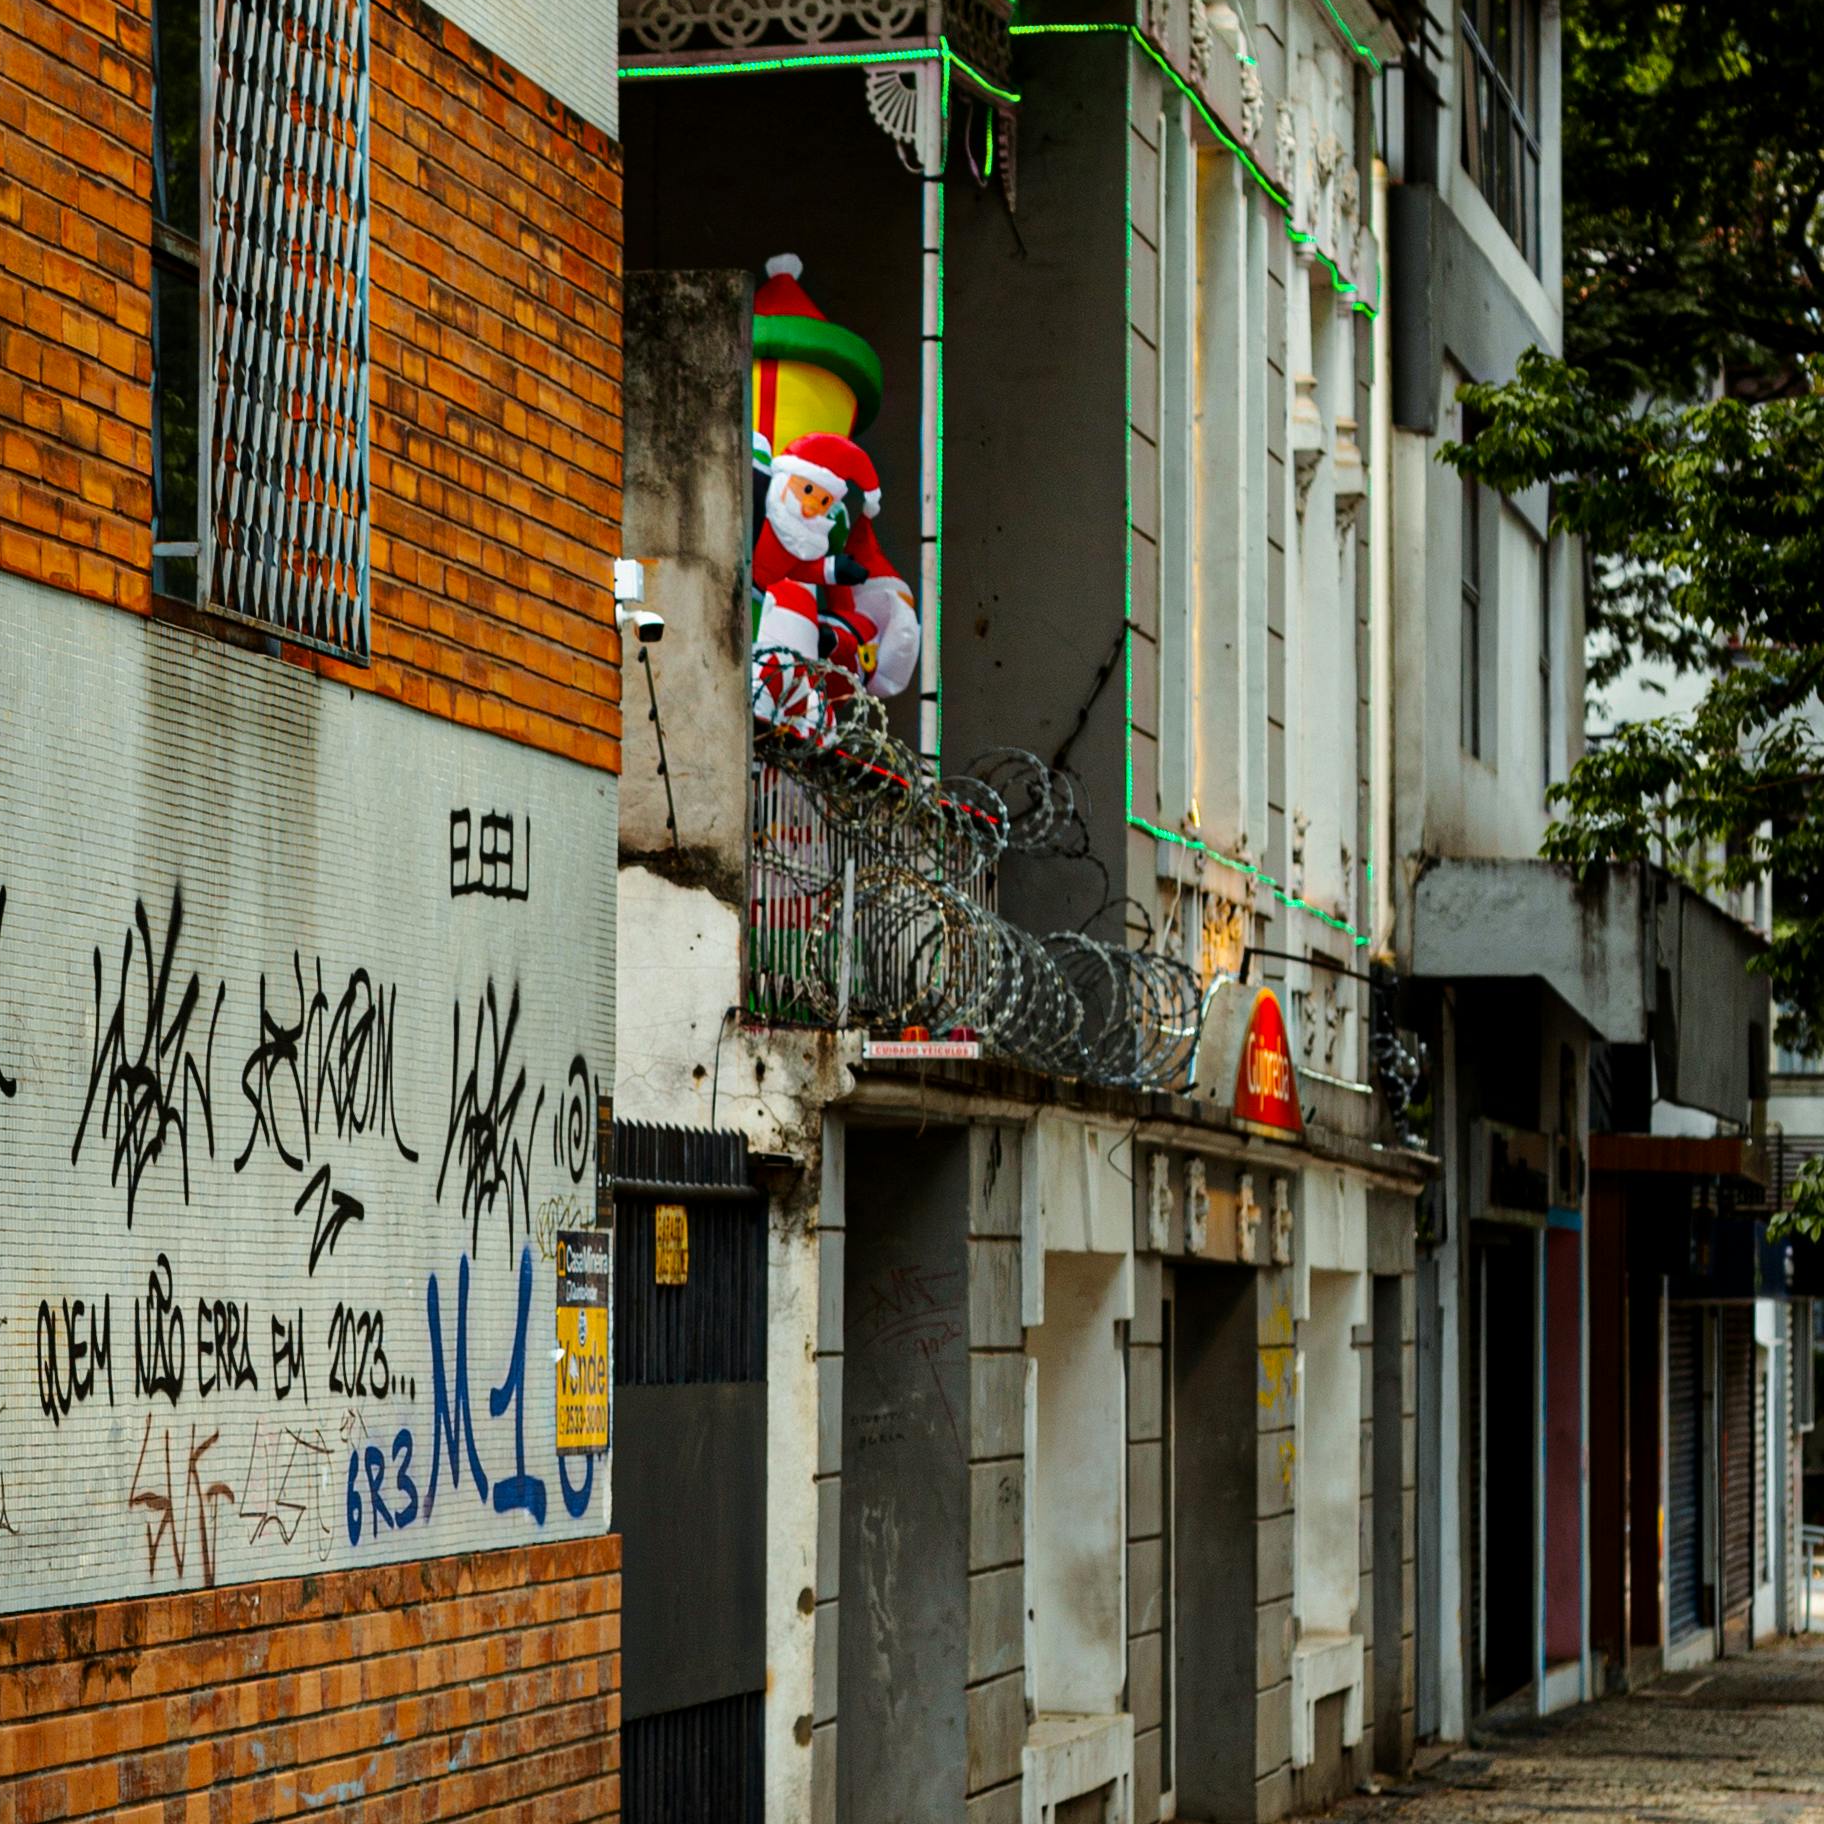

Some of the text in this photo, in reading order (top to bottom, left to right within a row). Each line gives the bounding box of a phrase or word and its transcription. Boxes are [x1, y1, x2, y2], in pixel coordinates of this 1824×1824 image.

[37, 1292, 113, 1427] QUEM
[135, 1253, 184, 1408] NÃO
[197, 1296, 258, 1398] ERRA
[272, 1306, 309, 1406] EM
[327, 1301, 416, 1401] 2023...
